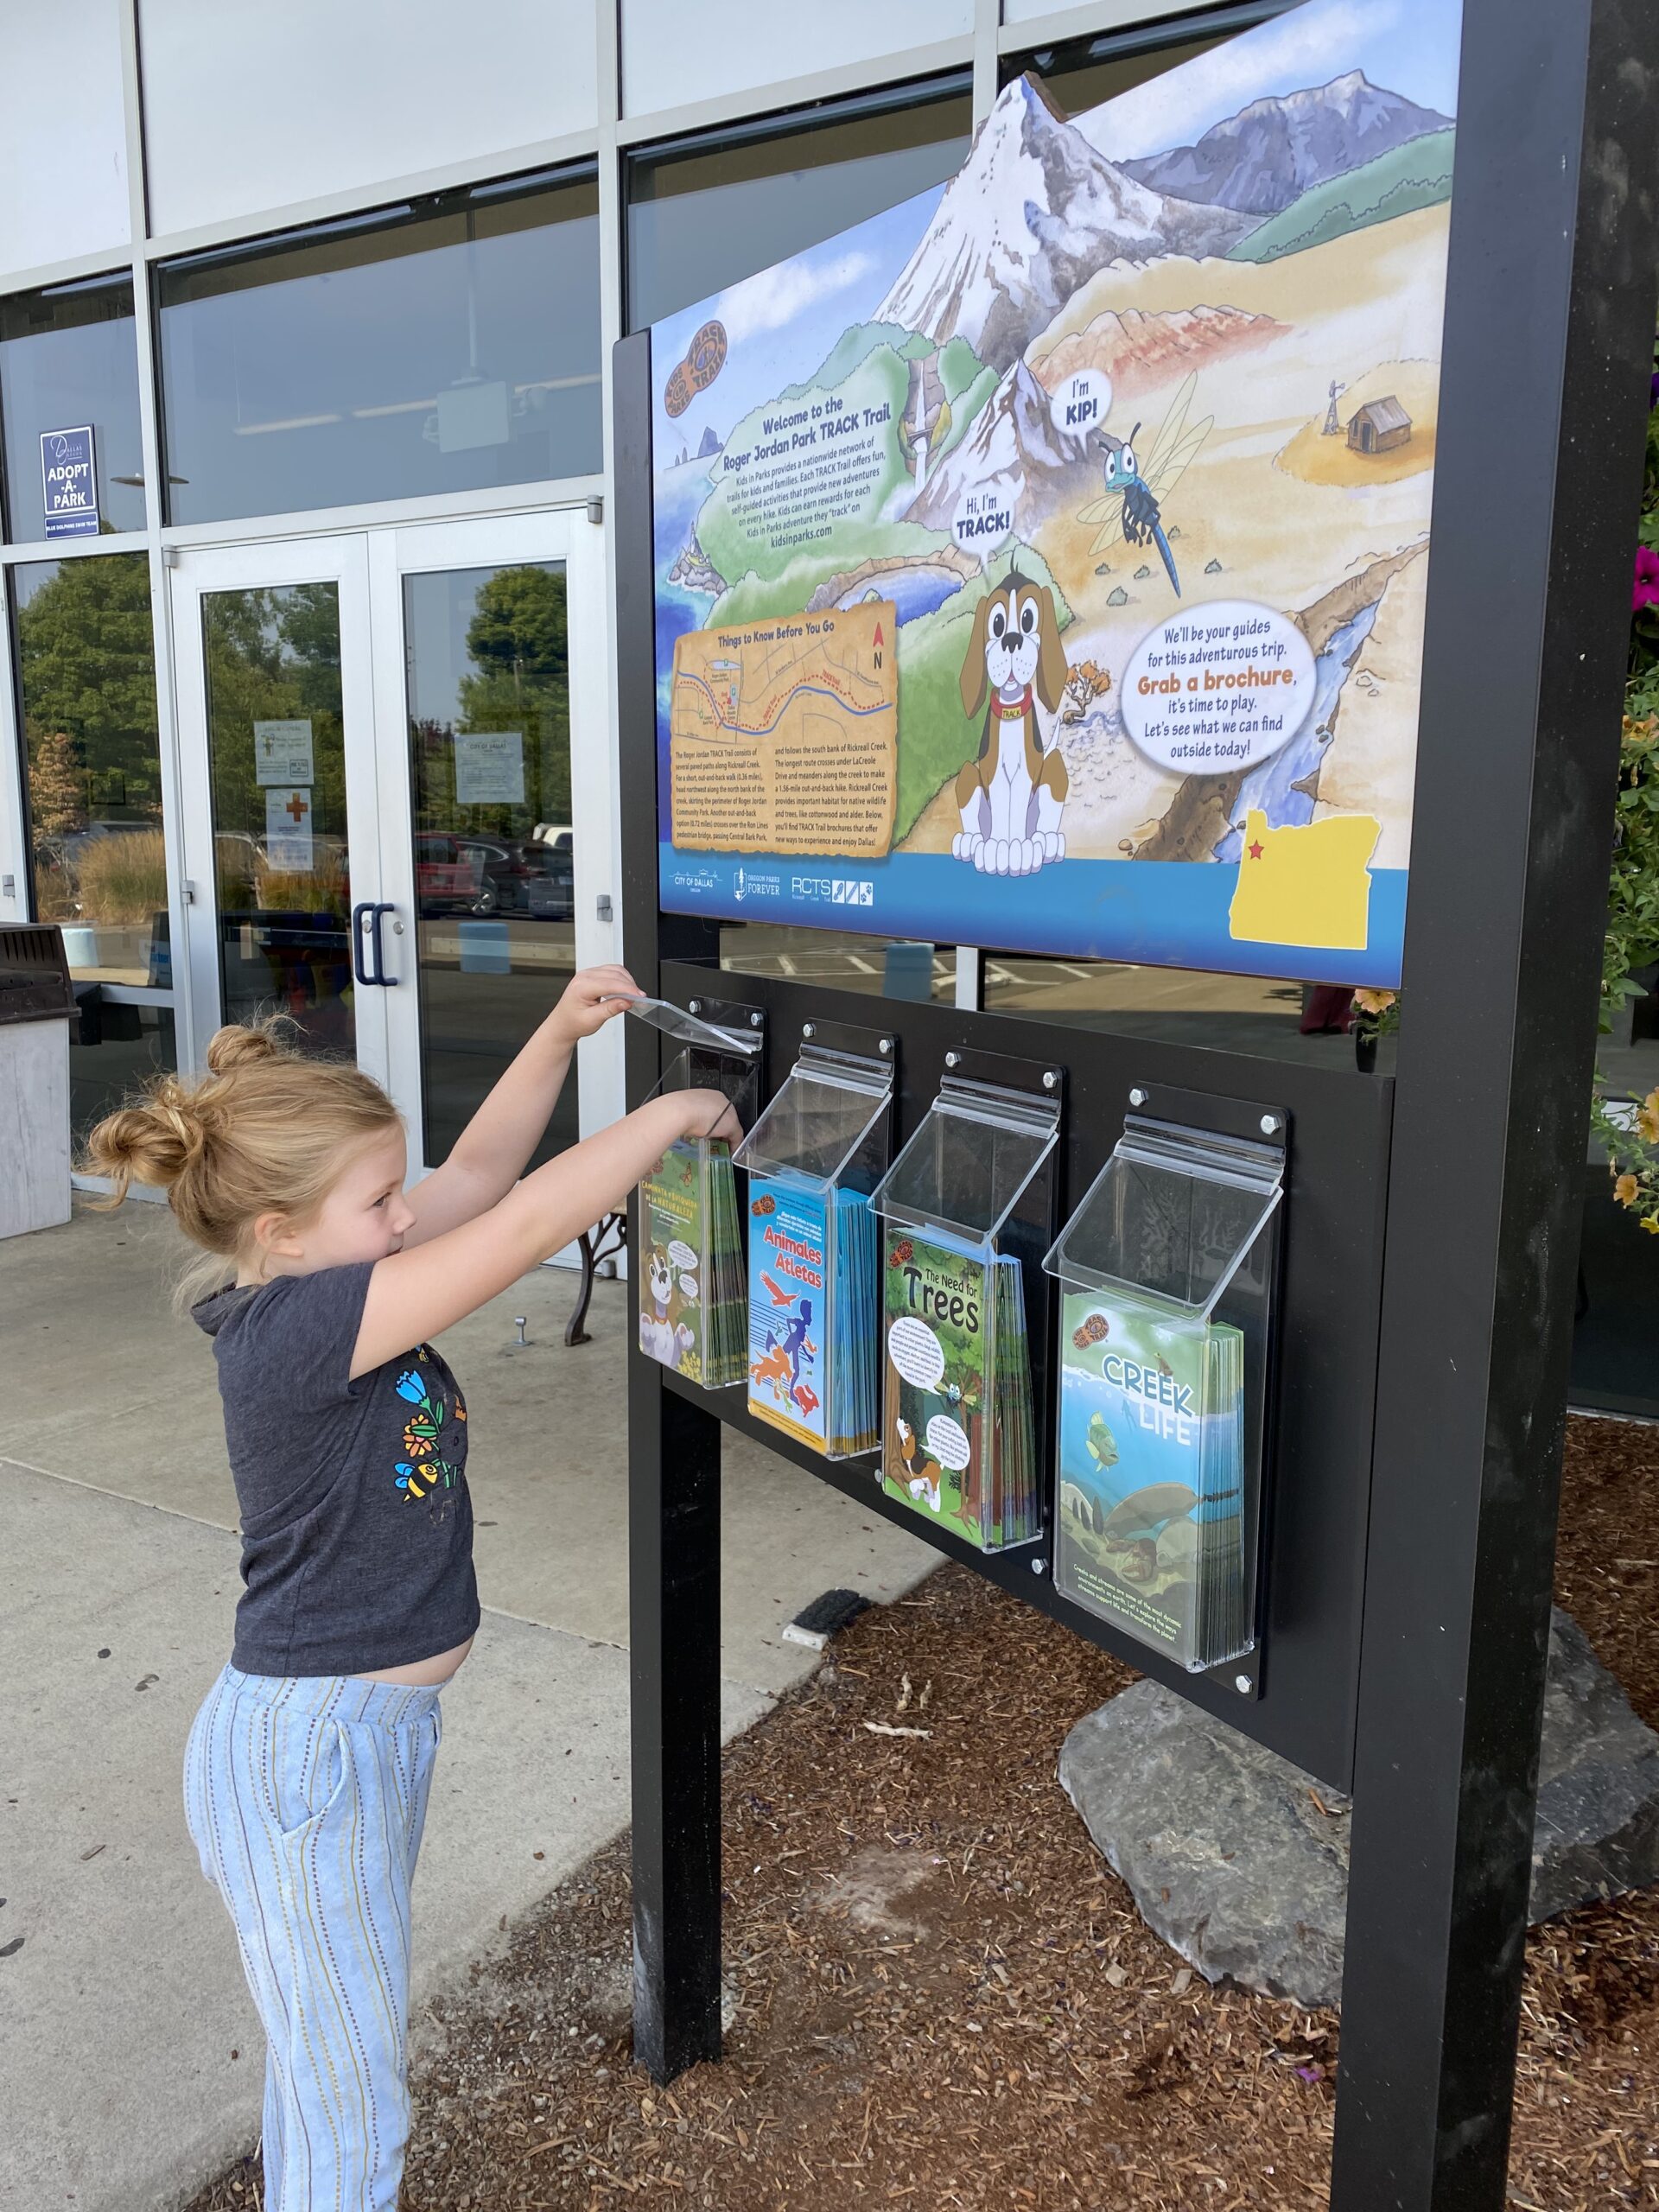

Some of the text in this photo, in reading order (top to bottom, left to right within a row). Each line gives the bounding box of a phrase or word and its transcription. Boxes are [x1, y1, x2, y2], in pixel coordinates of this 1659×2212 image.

[688, 325, 726, 366] TRACK
[692, 347, 724, 387] TRAIL
[666, 367, 683, 397] KIDS
[1073, 378, 1089, 397] I'm
[668, 391, 690, 413] PARKS
[763, 397, 842, 435] Welcome to the
[1066, 398, 1097, 425] KIP!
[724, 403, 891, 471] Roger Jordan Park TRACK Trail
[48, 463, 88, 481] ADOPT
[736, 476, 747, 486] Kids
[749, 474, 753, 483] in
[755, 470, 770, 480] Parks
[772, 463, 796, 479] provides
[803, 449, 837, 467] nationwide
[839, 439, 865, 456] network
[868, 435, 874, 448] of
[61, 480, 77, 493] -A-
[728, 493, 740, 503] trails
[751, 486, 761, 496] kids
[763, 481, 773, 493] and
[775, 476, 798, 489] families.
[800, 470, 814, 482] Each
[816, 463, 836, 477] TRACK
[837, 459, 850, 471] Trail
[852, 454, 870, 467] offers
[873, 451, 885, 461] fun,
[732, 467, 880, 515] self-guided activities that provide new adventures
[54, 492, 86, 508] PARK
[747, 515, 762, 524] every
[763, 510, 777, 519] hike.
[779, 505, 790, 516] Kids
[804, 501, 817, 510] earn
[818, 492, 842, 506] rewards
[844, 490, 854, 499] for
[855, 484, 870, 496] each
[967, 493, 996, 515] Hi, I'm
[747, 528, 759, 537] Kids
[760, 526, 765, 535] in
[766, 522, 781, 533] Parks
[783, 517, 812, 529] adventure
[815, 512, 828, 522] they
[772, 526, 832, 548] kidsinparks.com
[957, 511, 1009, 539] TRACK!
[718, 620, 834, 648] Things to Know Before You Go
[1165, 619, 1270, 644] We'll be your guides
[874, 652, 881, 669] N
[1148, 641, 1287, 667] for this adventurous trip.
[1138, 665, 1296, 695] Grab a brochure,
[1168, 694, 1256, 715] it's time to play.
[1145, 715, 1282, 737] Let's see what we can find
[871, 742, 887, 751] Creek.
[1171, 740, 1250, 759] outside today!
[695, 879, 713, 887] DALLAS
[747, 883, 779, 895] FOREVER
[792, 877, 830, 895] RCTS
[764, 1225, 821, 1265] Animales
[775, 1252, 821, 1288] Atletas
[926, 1268, 977, 1298] The Need for
[903, 1267, 978, 1333] Trees
[1103, 1353, 1195, 1418] CREEK
[1140, 1402, 1191, 1446] LIFE
[1074, 1564, 1088, 1576] Creeks
[1098, 1578, 1116, 1591] streams
[1126, 1592, 1136, 1602] some
[1152, 1608, 1162, 1617] most
[1163, 1613, 1181, 1628] dynamic
[1078, 1576, 1105, 1593] environments
[1140, 1610, 1155, 1622] explore
[1165, 1624, 1176, 1634] ways
[1078, 1584, 1095, 1596] streams
[1096, 1593, 1112, 1605] support
[1130, 1611, 1152, 1629] transform
